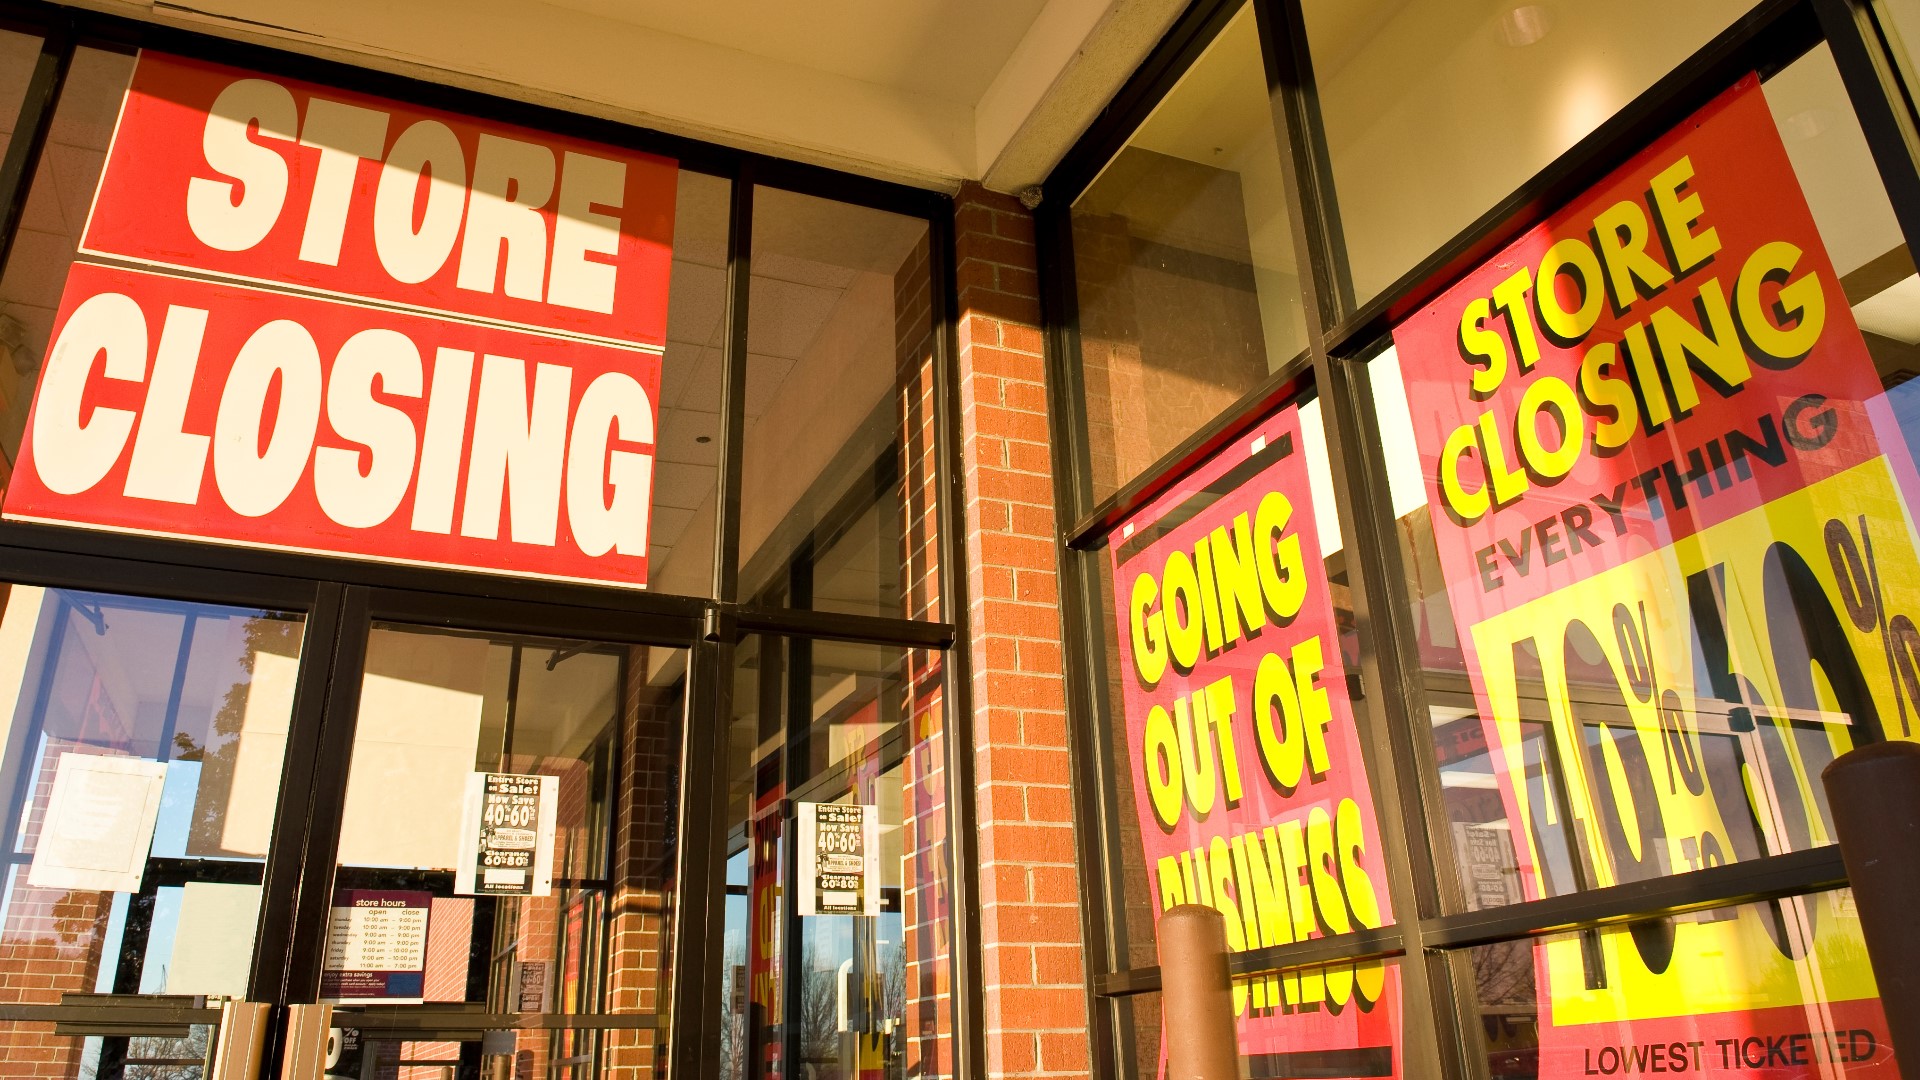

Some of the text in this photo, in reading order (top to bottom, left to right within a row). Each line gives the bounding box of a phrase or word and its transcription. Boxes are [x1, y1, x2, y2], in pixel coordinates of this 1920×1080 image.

[187, 79, 627, 314] STORE
[1457, 156, 1722, 398] STORE
[32, 292, 655, 557] CLOSING
[1437, 241, 1827, 527] CLOSING
[1475, 394, 1839, 594] EVERYTHING
[1130, 491, 1308, 690] GOING
[499, 784, 538, 794] Sale!
[1142, 636, 1334, 834] OUT OF
[488, 794, 535, 805] Now Save
[818, 805, 840, 813] Entire
[820, 823, 860, 832] Now Save
[829, 813, 861, 822] Sale!
[356, 898, 406, 907] store hours
[1585, 1028, 1876, 1075] LOWEST TICKETED
